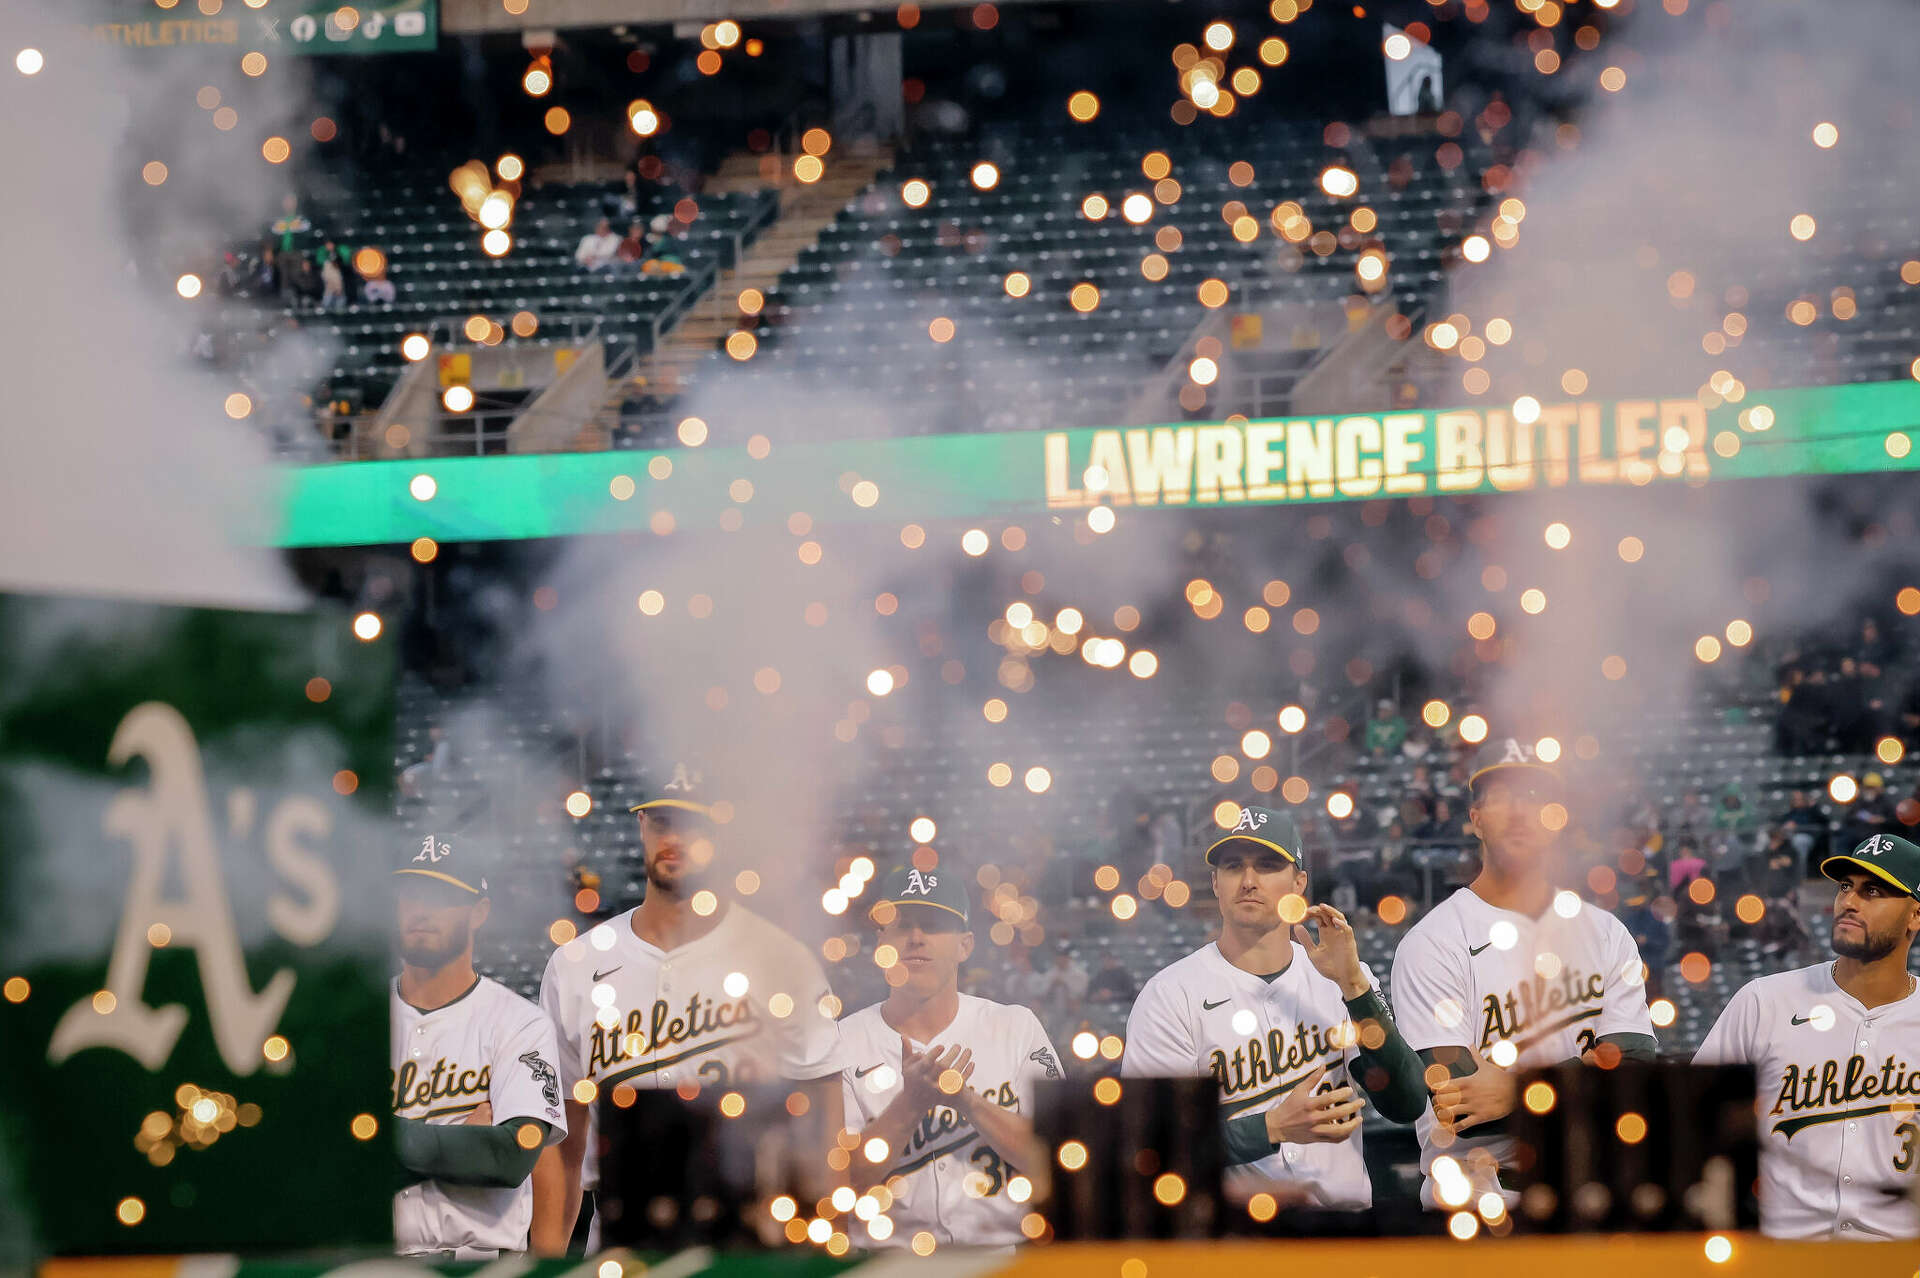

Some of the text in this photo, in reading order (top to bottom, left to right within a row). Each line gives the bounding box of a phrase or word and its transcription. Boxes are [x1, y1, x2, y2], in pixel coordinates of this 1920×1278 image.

[1045, 401, 1709, 508] LAWRENCE BUTLER
[1232, 808, 1268, 834] A's
[412, 835, 451, 863] A's
[1856, 834, 1895, 856] A's
[46, 700, 342, 1077] A's
[901, 869, 937, 896] A's
[1210, 1020, 1346, 1095] Athletic
[391, 1057, 491, 1110] letics
